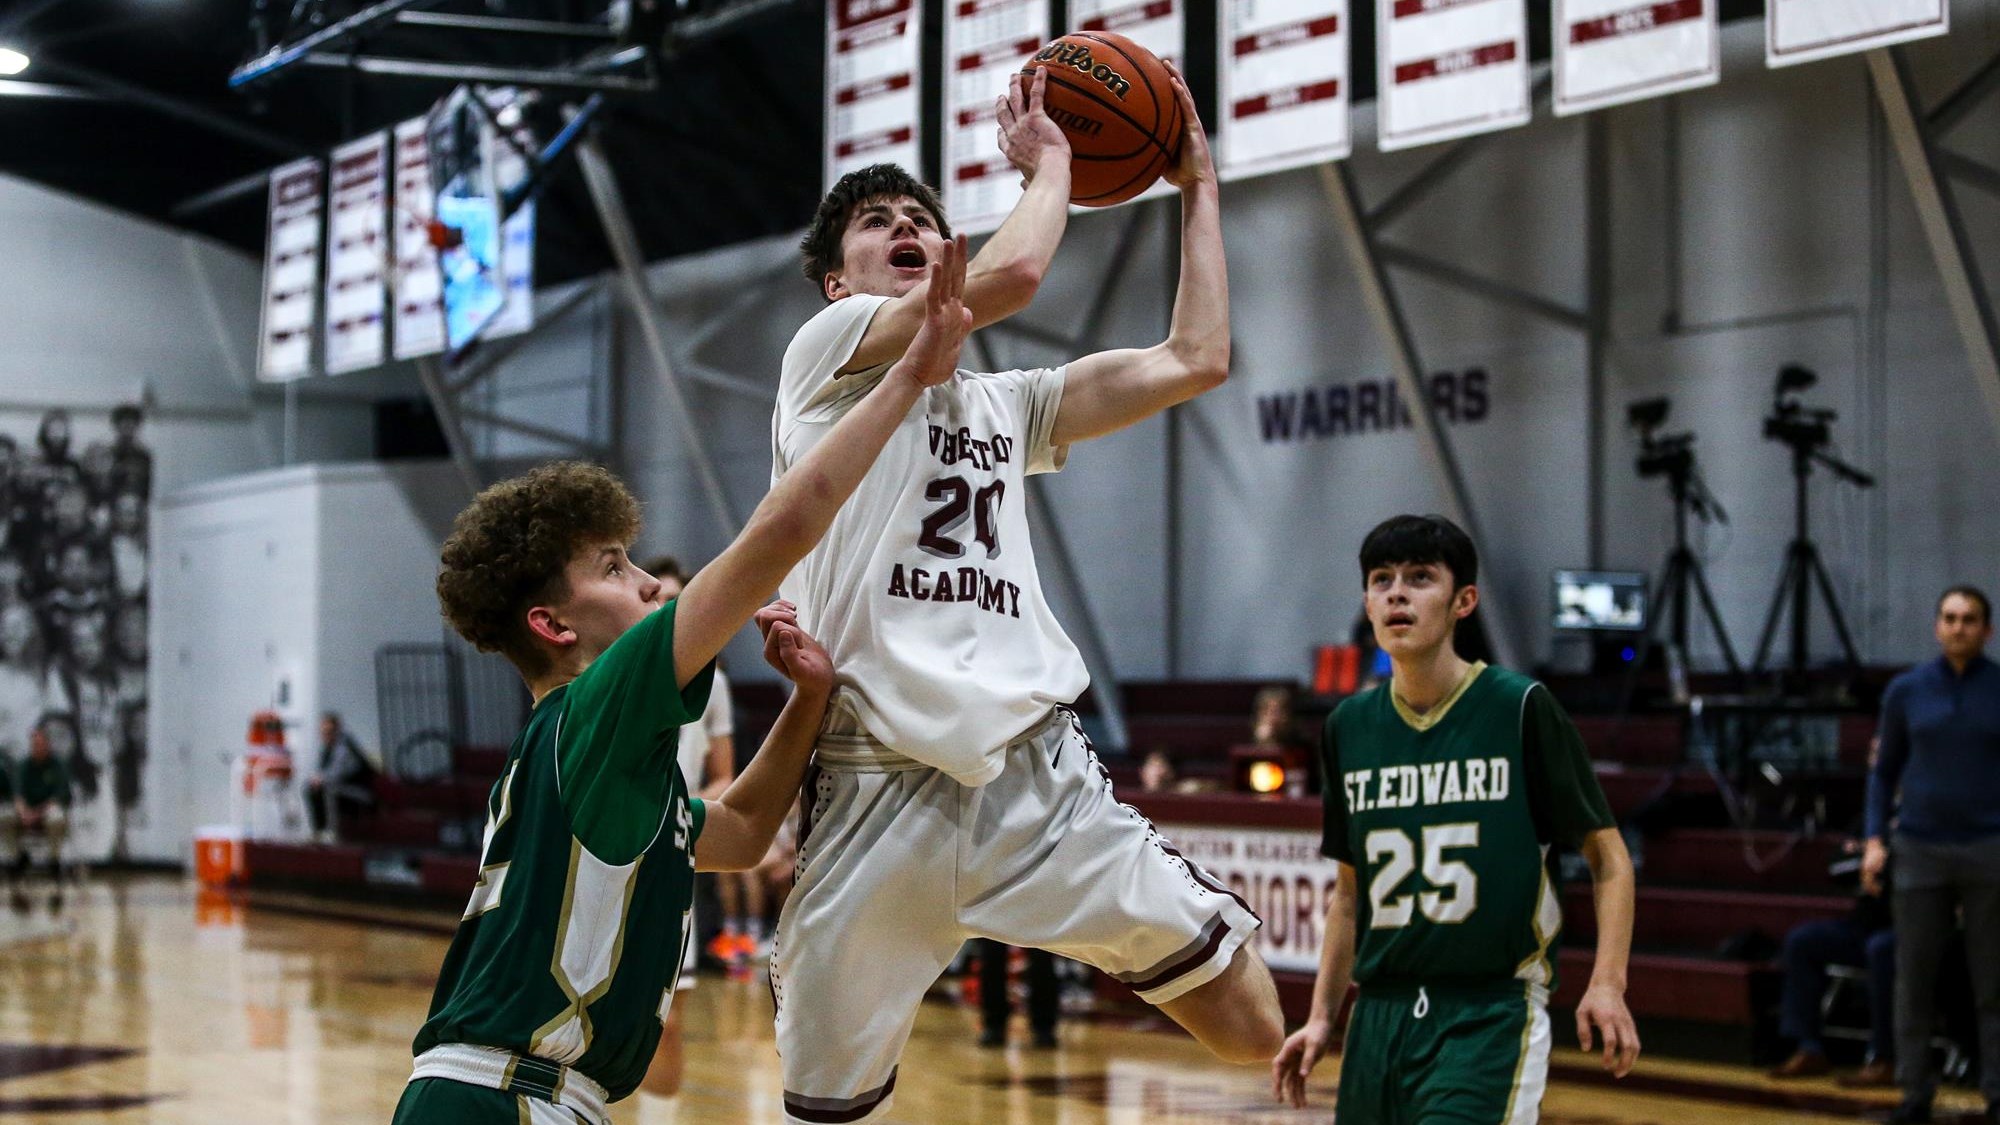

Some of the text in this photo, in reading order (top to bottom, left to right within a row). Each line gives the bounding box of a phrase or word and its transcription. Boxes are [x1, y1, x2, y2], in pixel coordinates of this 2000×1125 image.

[1035, 41, 1131, 102] Wilson
[1257, 366, 1490, 443] WARRIRS
[888, 563, 1021, 619] ACADMY
[1365, 821, 1480, 930] 25
